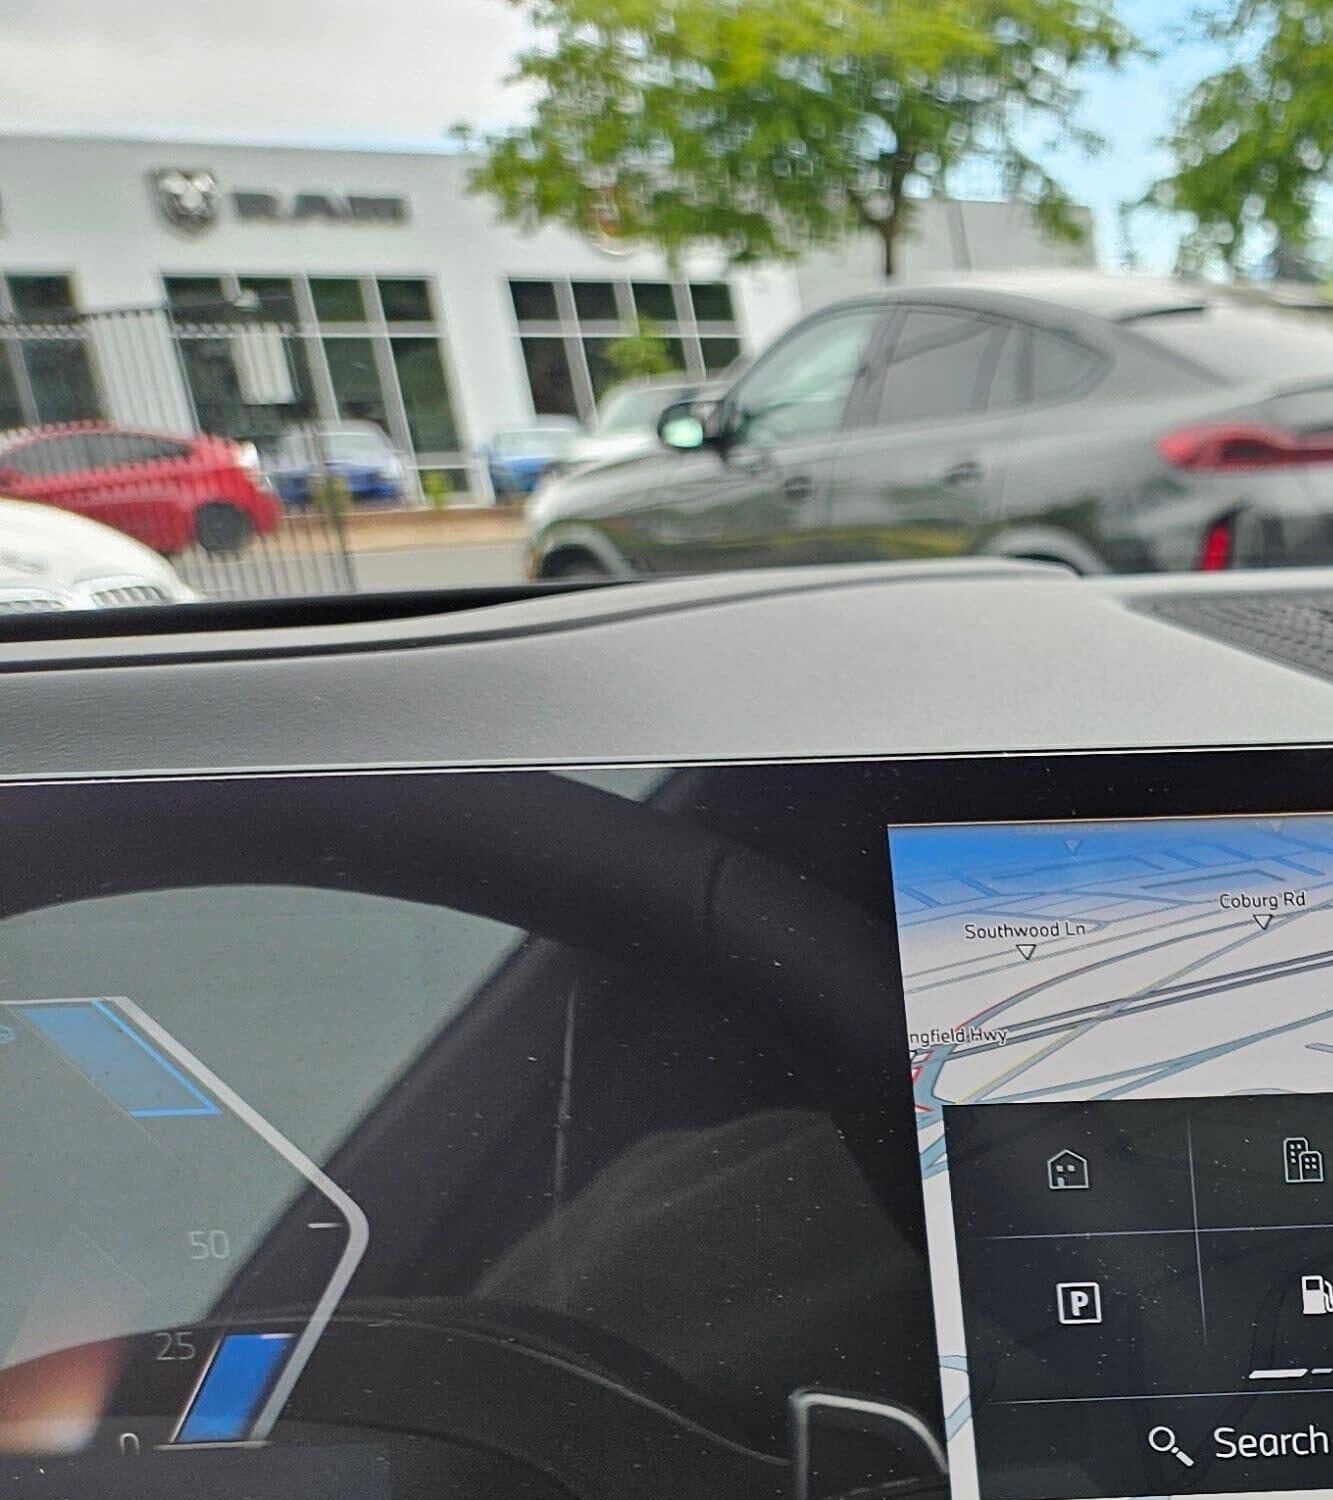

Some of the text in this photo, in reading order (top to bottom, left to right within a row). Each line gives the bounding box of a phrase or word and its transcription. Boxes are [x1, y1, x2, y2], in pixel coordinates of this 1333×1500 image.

[1220, 892, 1305, 911] Coburg Rd
[965, 921, 1086, 940] Southwood Ln
[970, 1028, 1008, 1045] Hwy
[190, 1230, 229, 1260] 50
[156, 1331, 195, 1361] 25
[1214, 1425, 1330, 1460] Search
